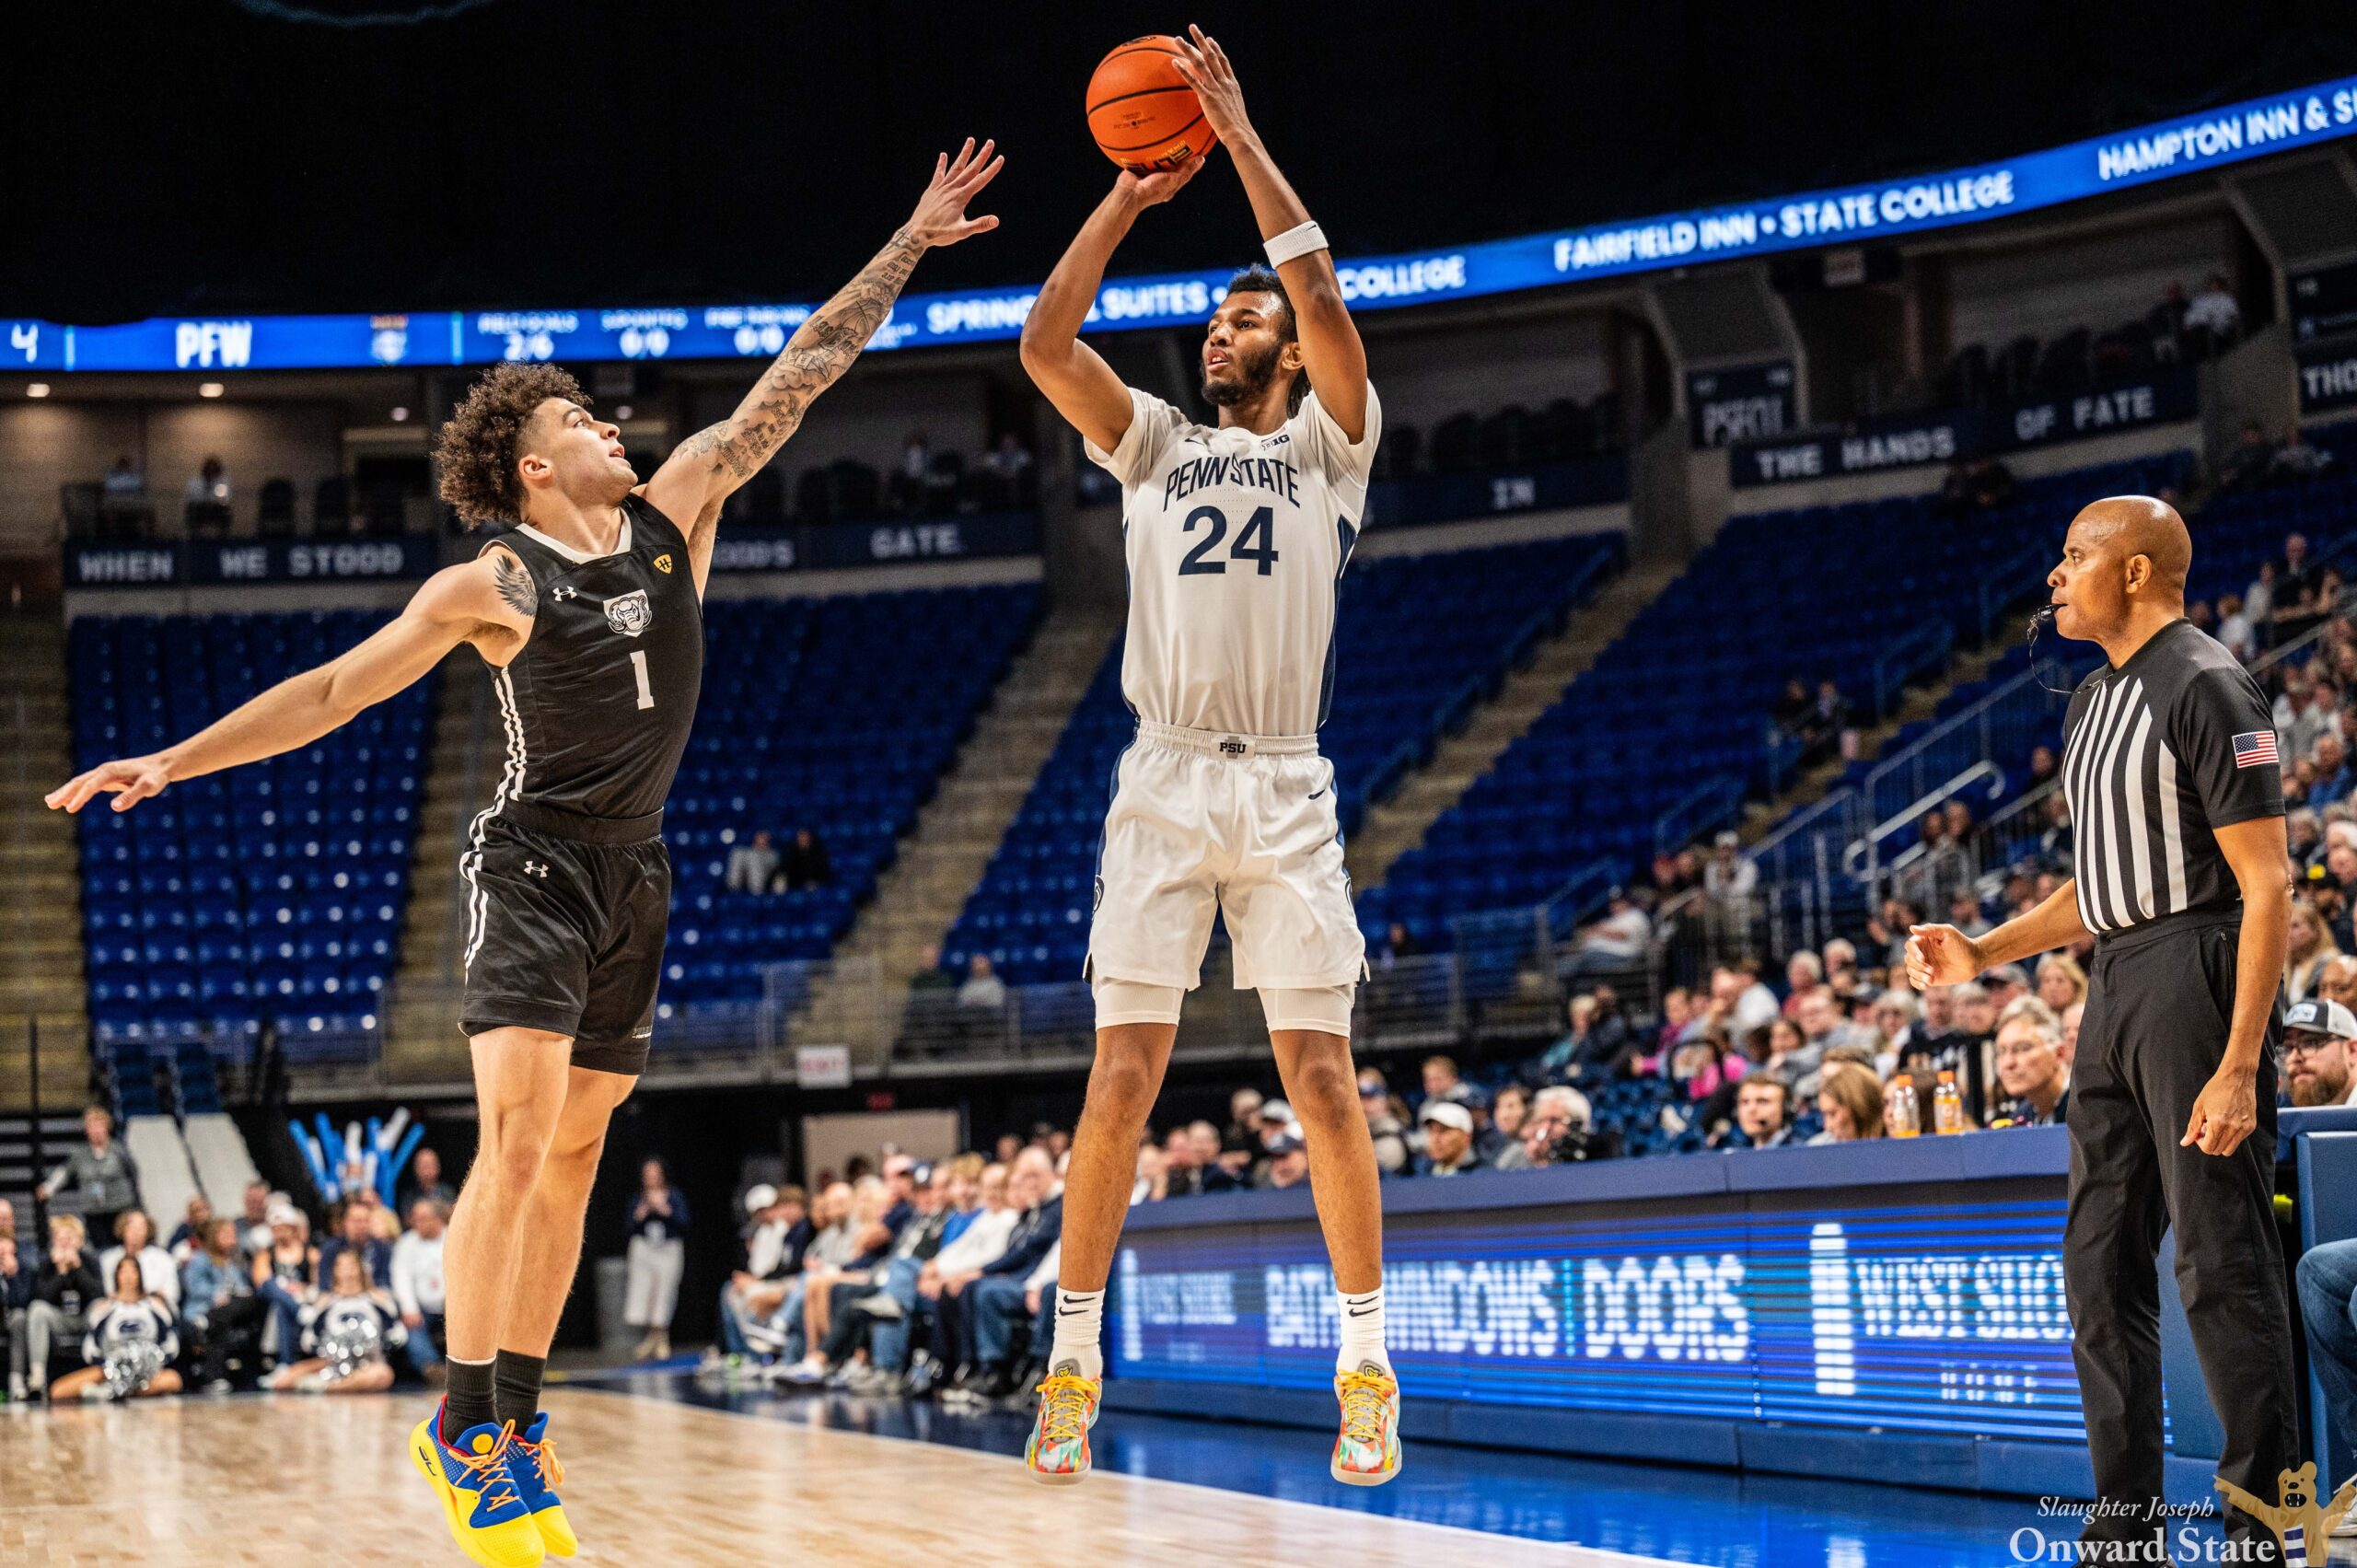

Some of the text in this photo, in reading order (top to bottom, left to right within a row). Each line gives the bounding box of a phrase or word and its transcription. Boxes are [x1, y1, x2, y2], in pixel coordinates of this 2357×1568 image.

[2098, 113, 2243, 180] HAMPTON
[2246, 99, 2300, 145] INN
[2304, 94, 2331, 131] &
[1553, 170, 2014, 273] FAIRFIELD INN STATE COLLEGE
[1101, 281, 1209, 319] SUITES
[1342, 254, 1467, 299] COLLEGE
[11, 324, 39, 363] 4
[175, 321, 251, 367] PFW
[1754, 387, 2154, 480] THE HANDS OF FATE
[1163, 452, 1300, 513] PENN STATE
[1491, 476, 1536, 510] IN
[77, 551, 175, 582] WHEN
[220, 546, 268, 578] WE
[288, 543, 405, 577] STOOD
[1178, 505, 1279, 575] 24
[629, 650, 655, 710] 1
[1219, 742, 1247, 754] PSU
[1582, 1254, 1749, 1362] DOORS
